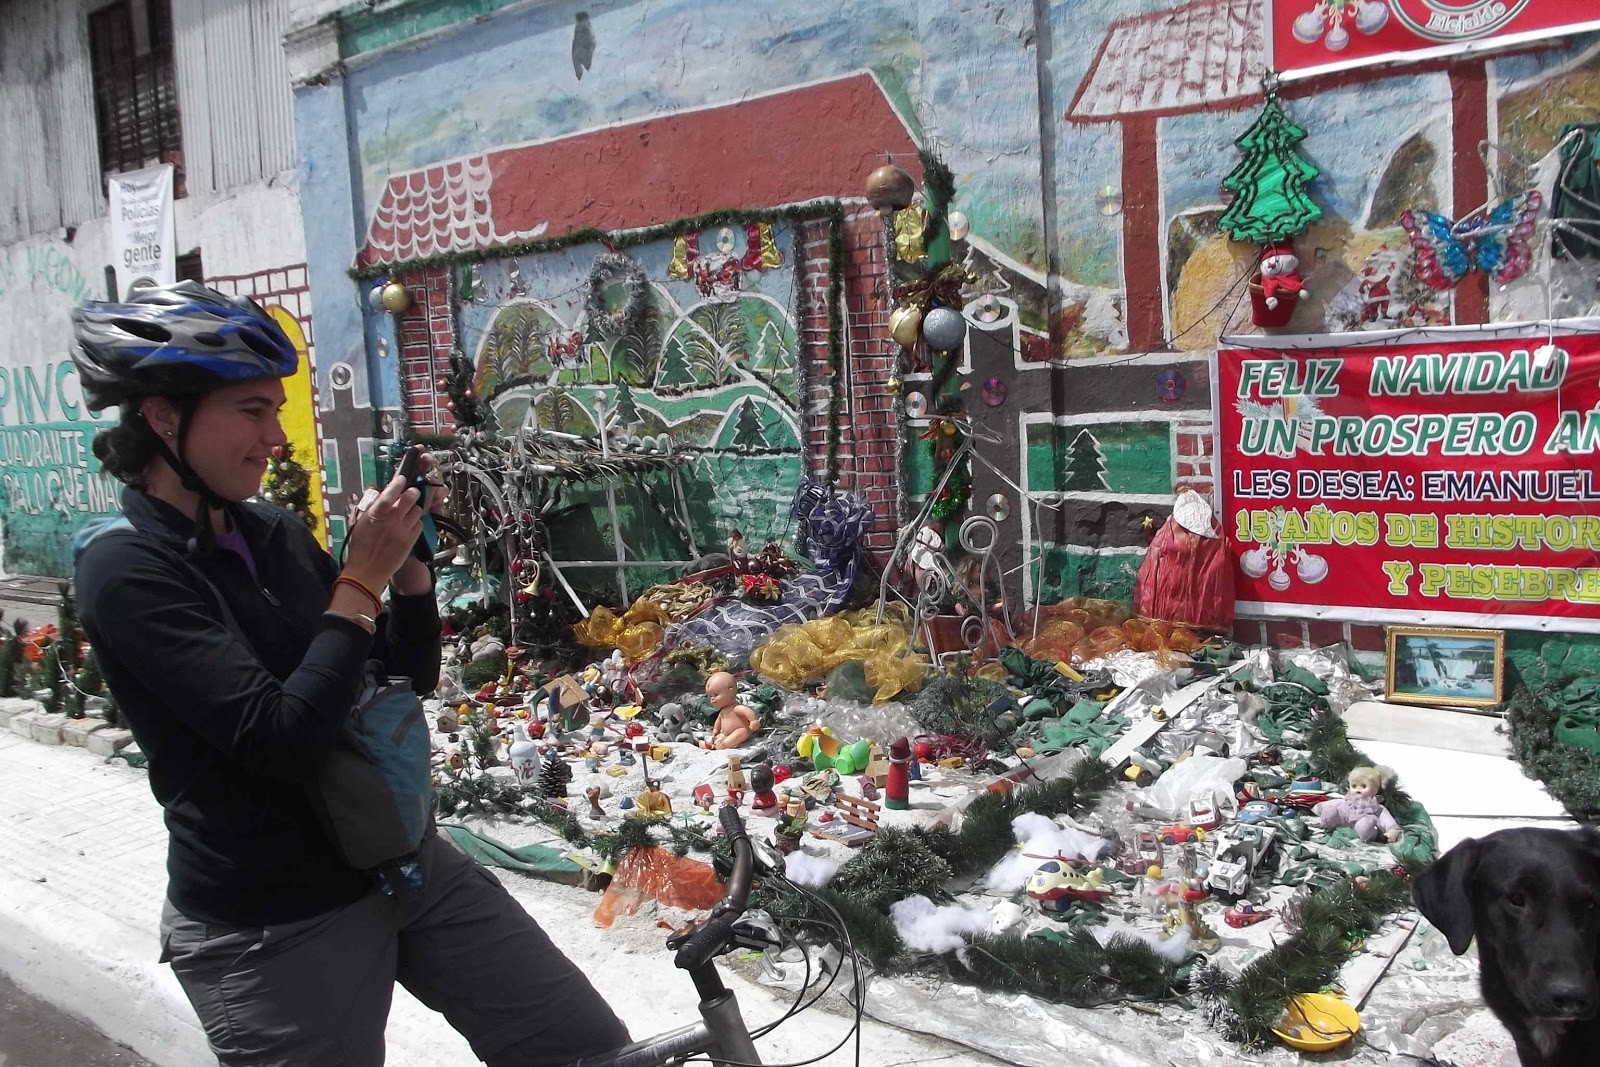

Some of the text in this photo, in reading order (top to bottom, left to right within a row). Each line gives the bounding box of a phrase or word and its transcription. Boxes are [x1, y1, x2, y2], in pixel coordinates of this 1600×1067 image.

[124, 244, 161, 268] gente
[1237, 348, 1570, 398] FELIZ NAVIDAD
[1240, 416, 1298, 455] UN
[1311, 410, 1539, 456] PROSPERO
[1234, 470, 1600, 501] LES DESEA: EMANUEL
[1236, 504, 1600, 552] 15 AÑOS DE HISTOR
[1383, 561, 1600, 604] Y PESEBRE
